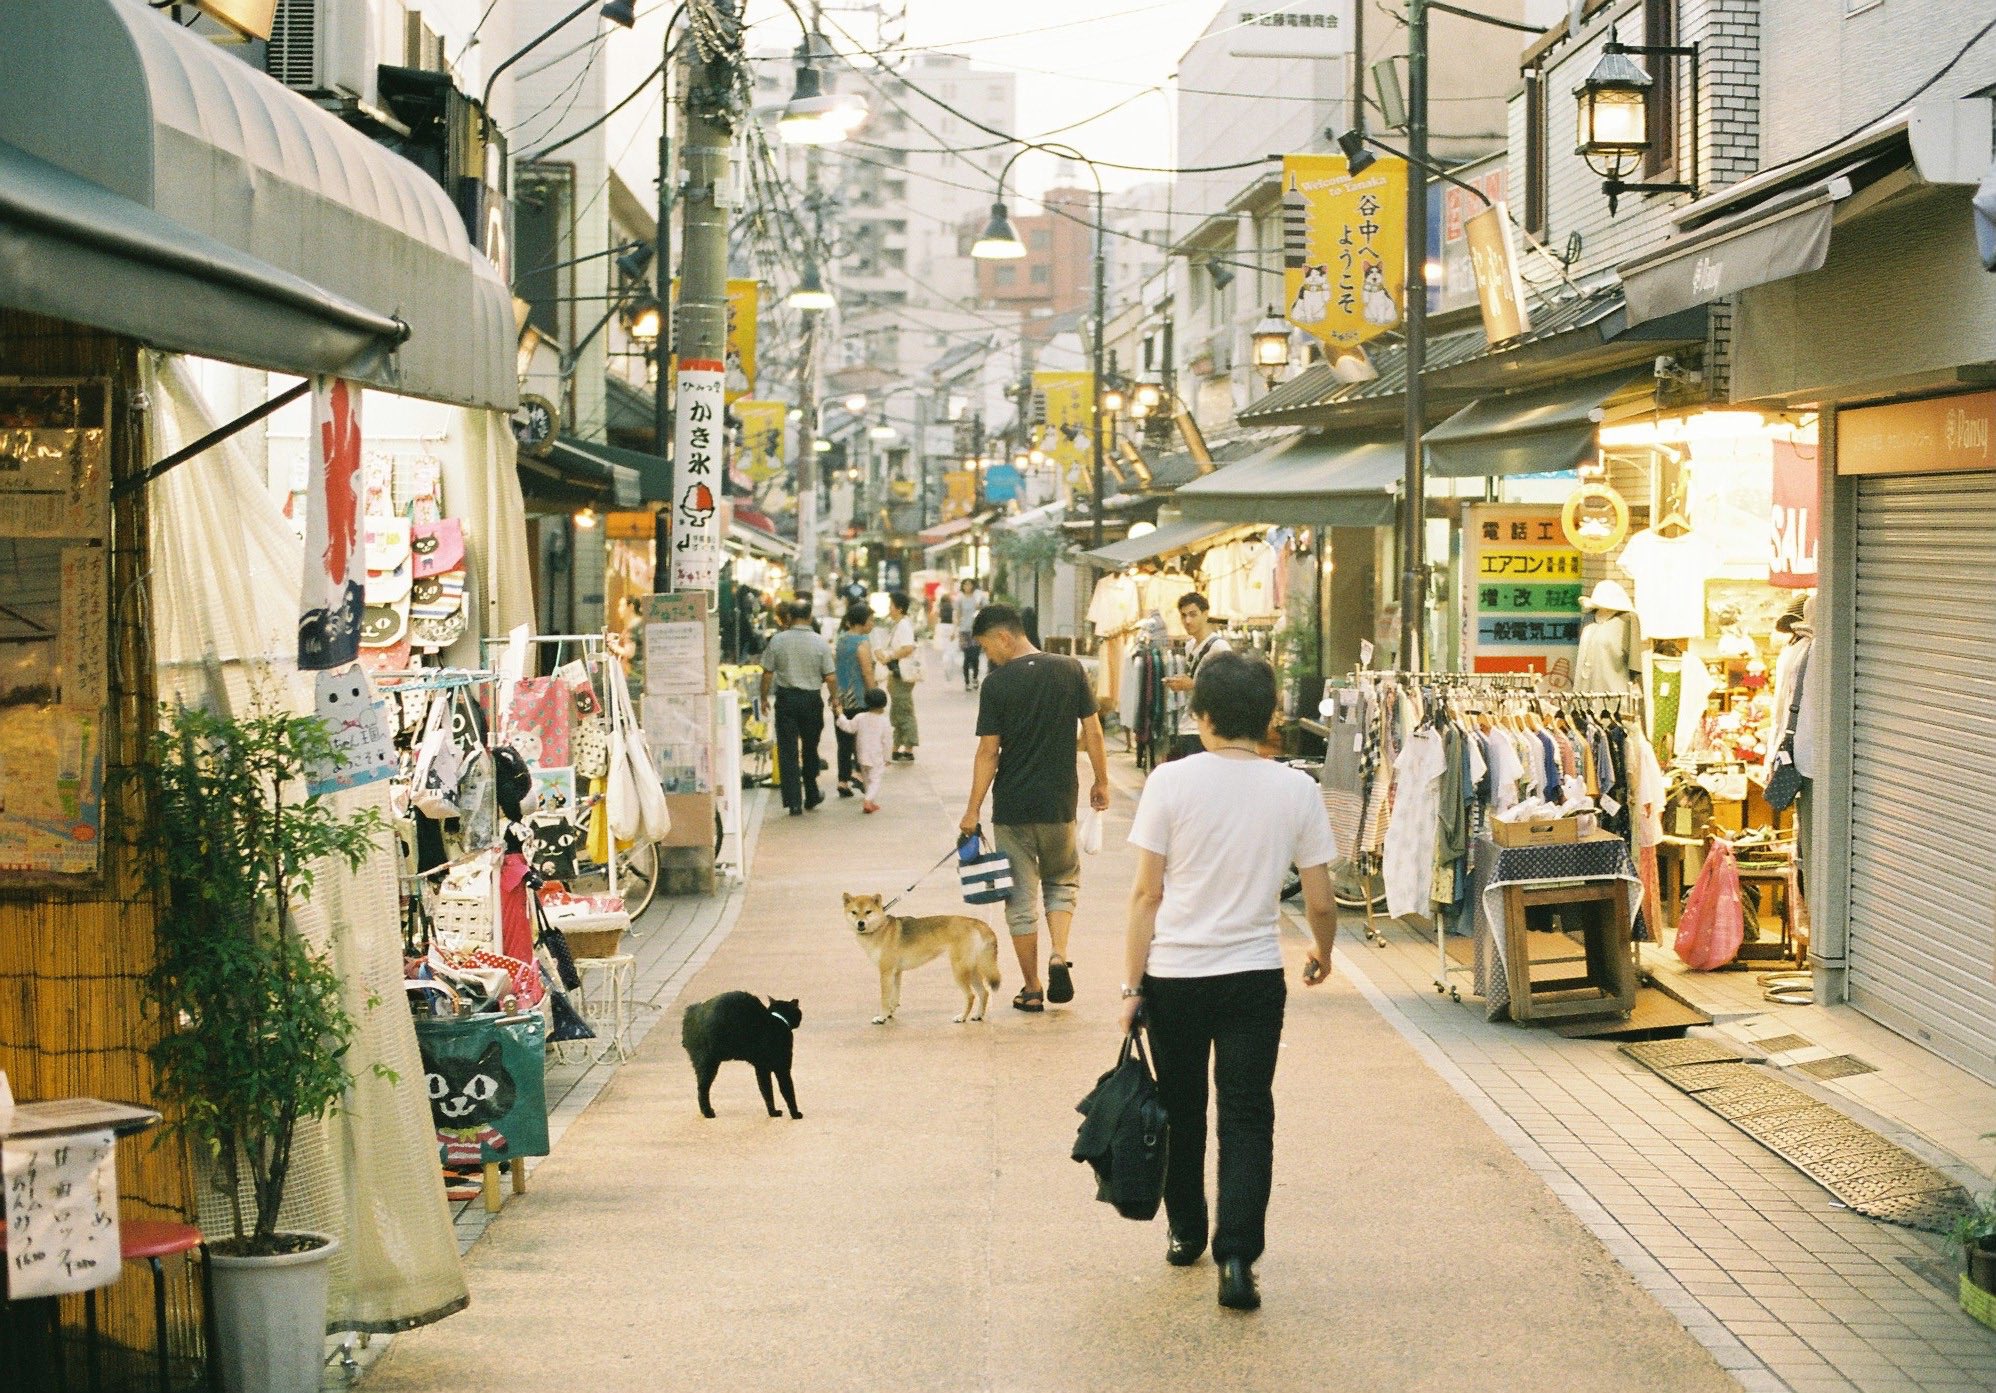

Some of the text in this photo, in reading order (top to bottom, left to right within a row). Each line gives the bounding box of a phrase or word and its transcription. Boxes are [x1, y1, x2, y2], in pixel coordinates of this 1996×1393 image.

[1358, 195, 1380, 259] 谷中へ
[1338, 224, 1355, 315] ようこそ
[688, 401, 712, 475] かき氷
[1481, 556, 1543, 573] エアコン
[1482, 521, 1553, 541] 電話工
[1770, 504, 1818, 574] SAL
